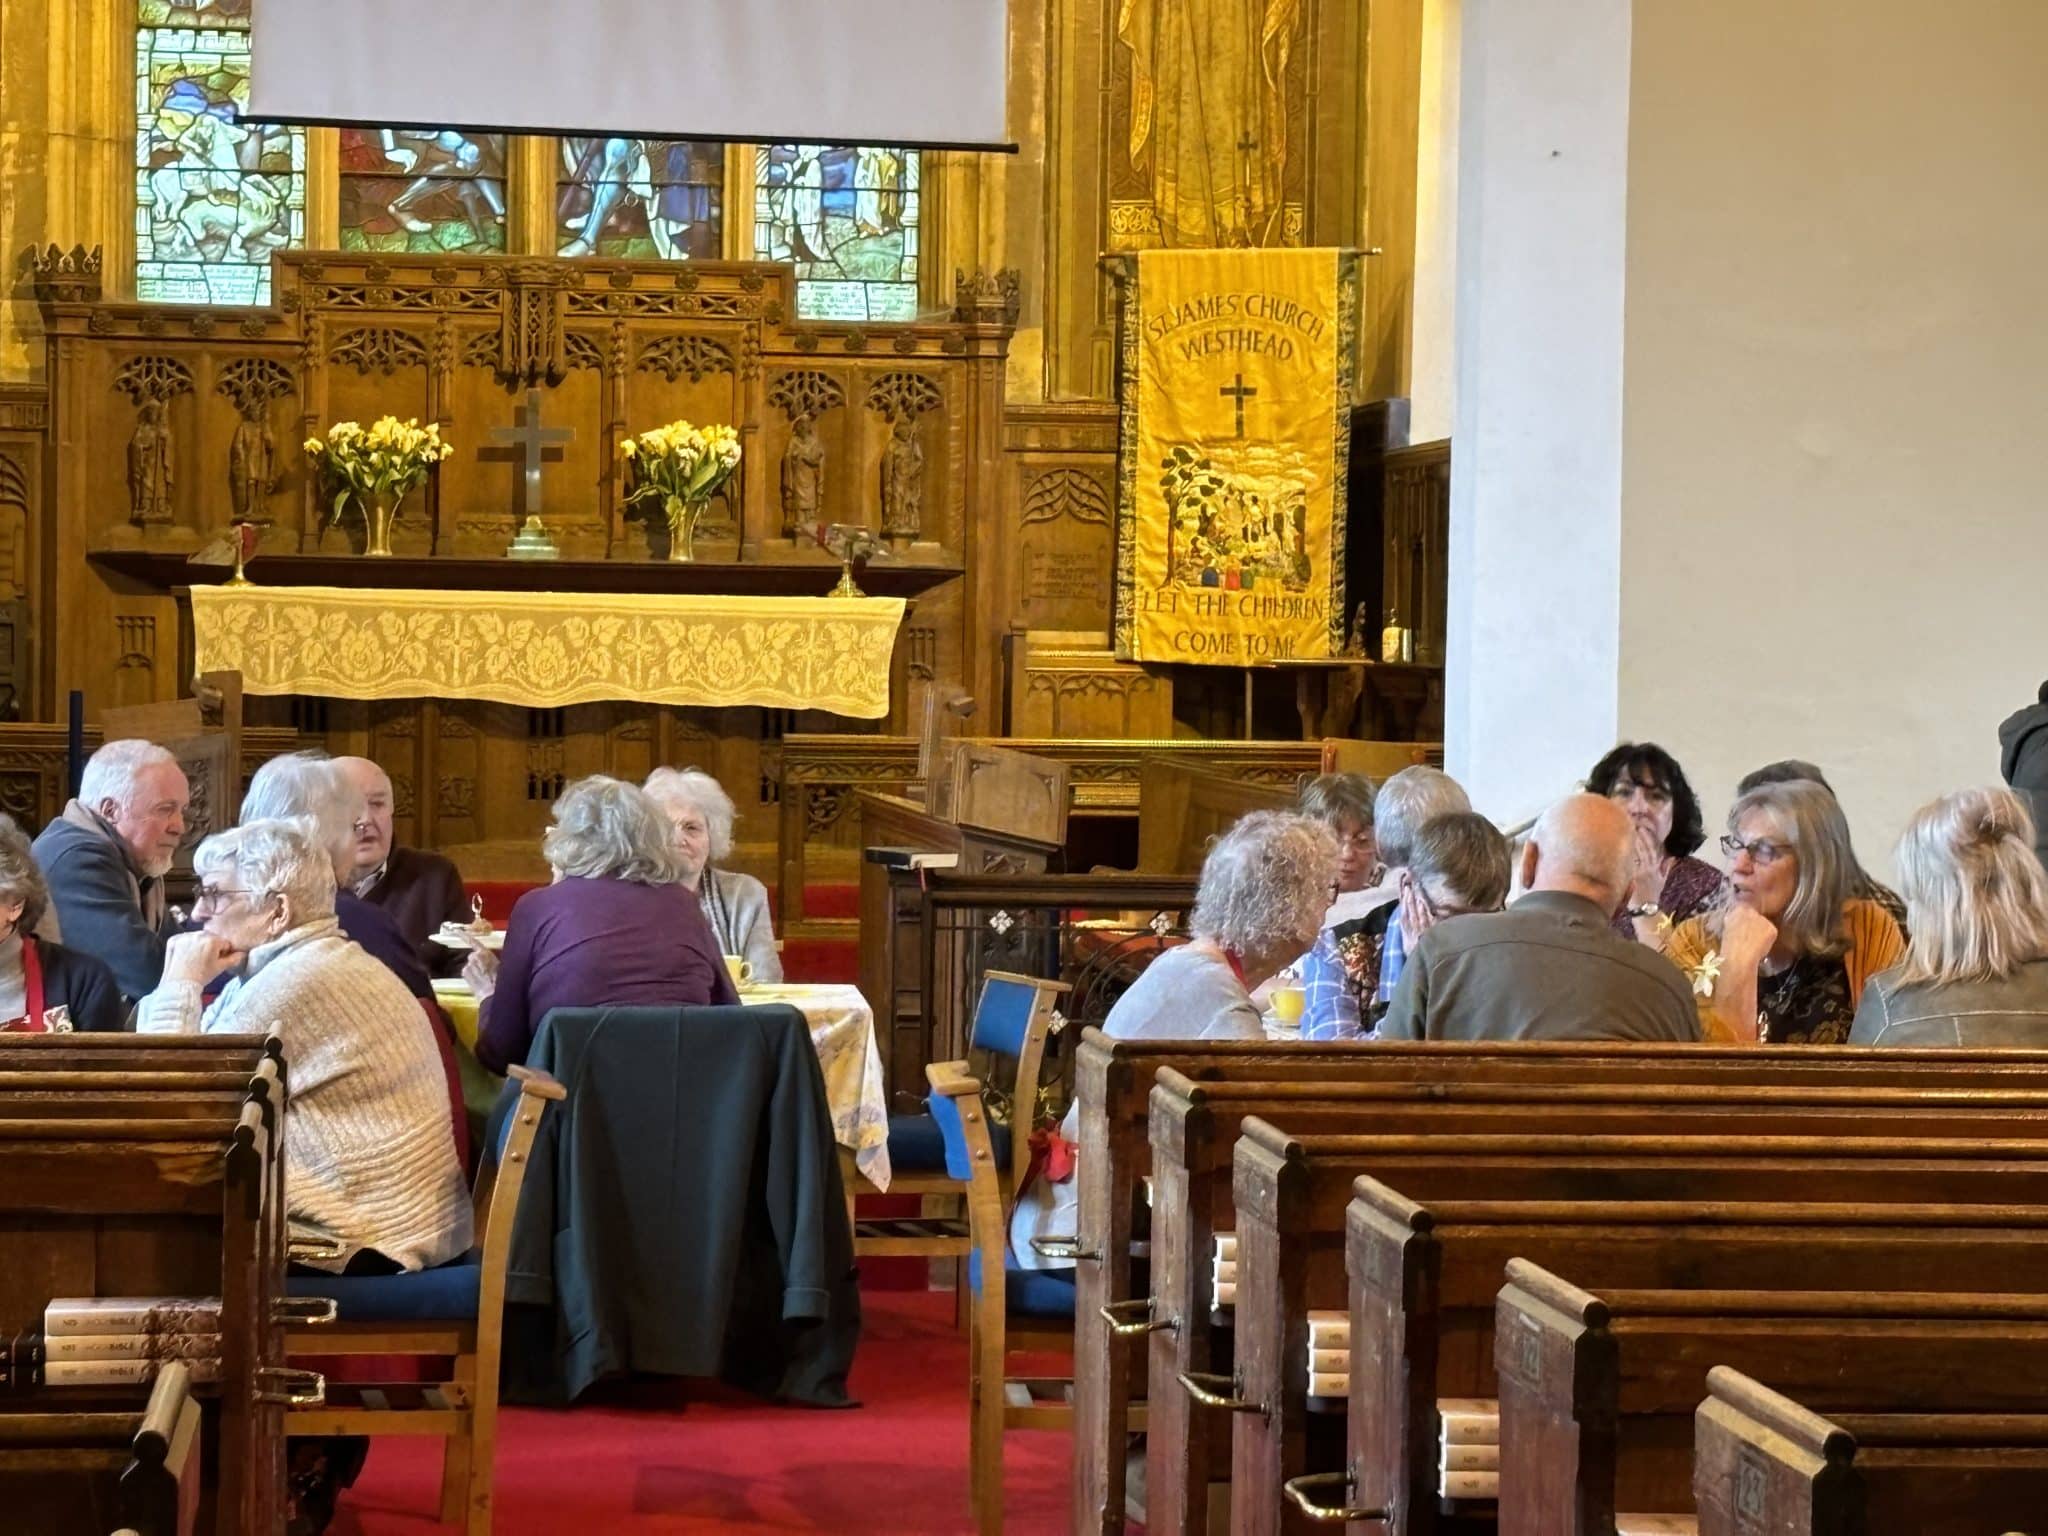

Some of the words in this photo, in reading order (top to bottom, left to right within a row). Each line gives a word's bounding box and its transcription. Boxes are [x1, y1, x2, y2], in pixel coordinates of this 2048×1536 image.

[1174, 294, 1241, 329] JAMES
[1245, 294, 1324, 343] CHURCH
[1180, 328, 1293, 361] WESTHEAD
[1142, 591, 1177, 615] LET
[1193, 593, 1230, 617] THE
[1238, 594, 1325, 620] CHILDREN
[1174, 630, 1234, 655] COME
[1244, 633, 1270, 657] TO
[1275, 636, 1297, 658] ME
